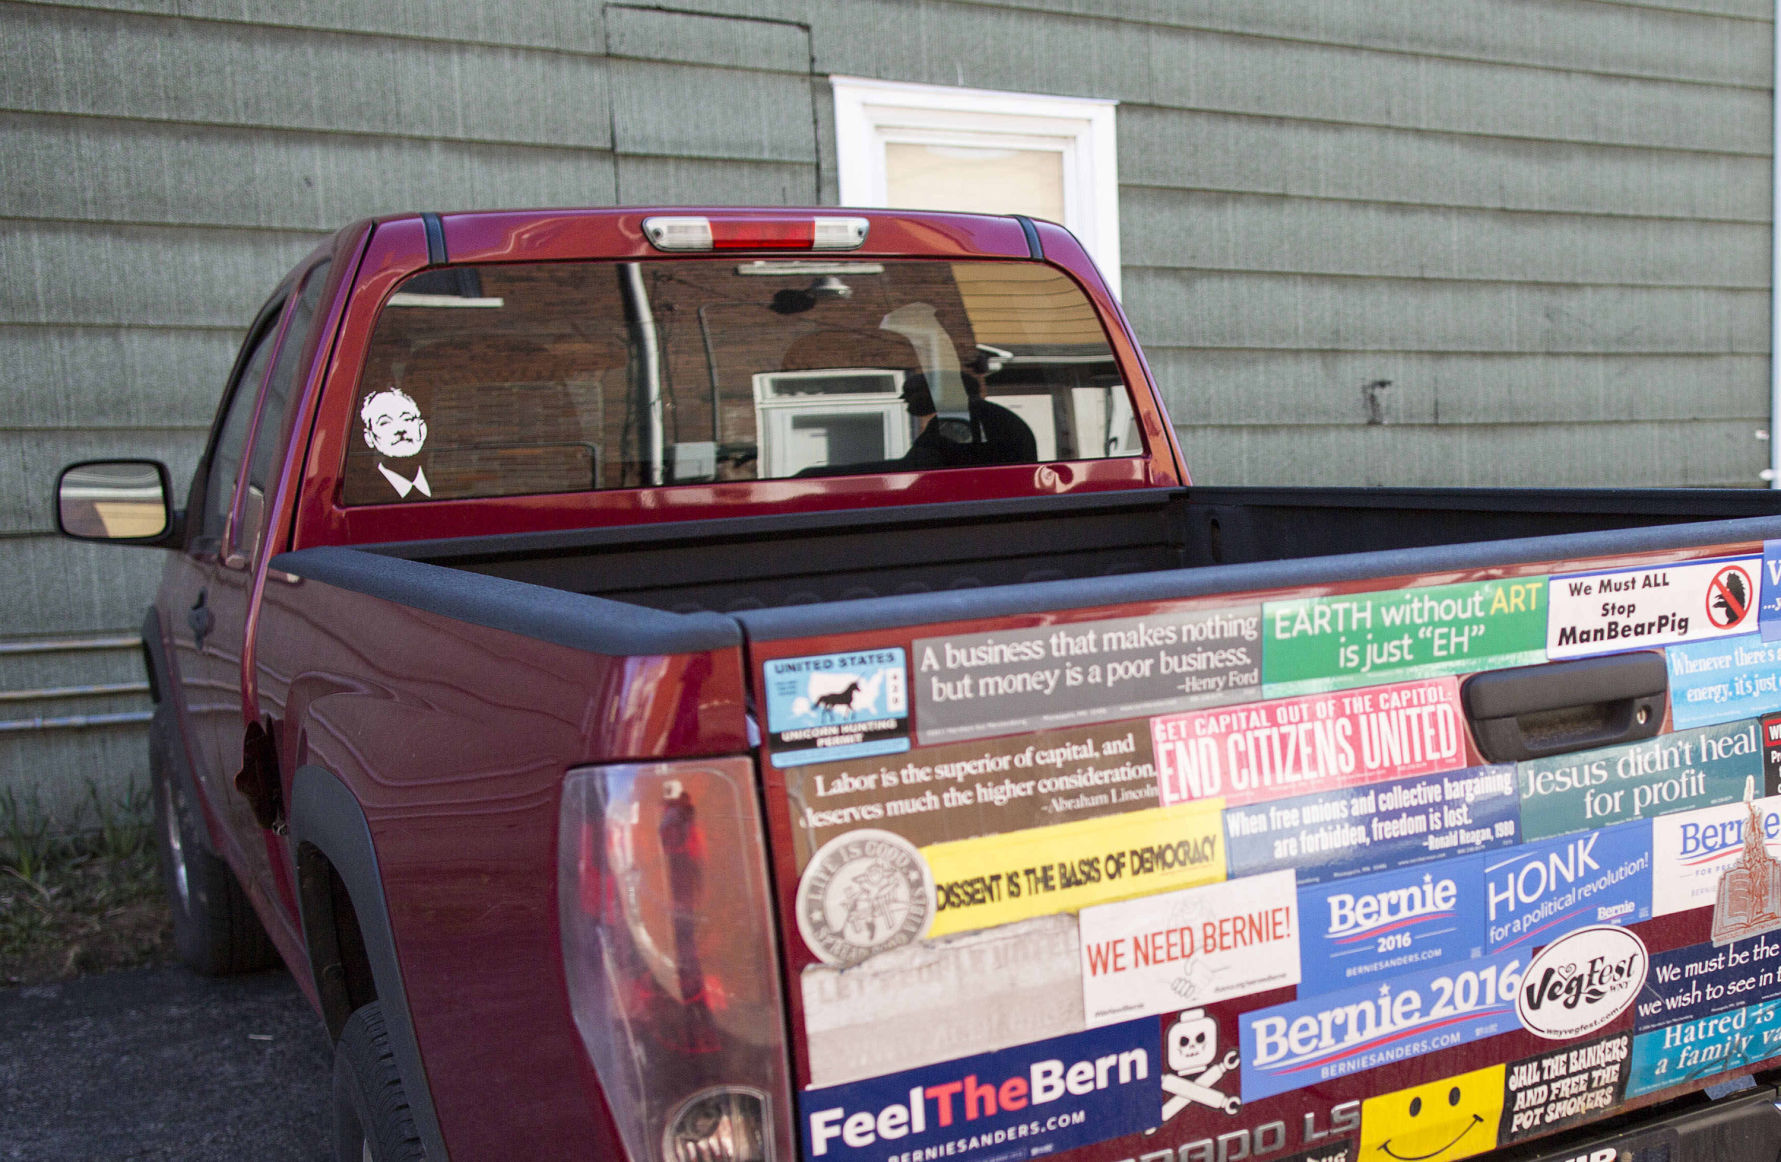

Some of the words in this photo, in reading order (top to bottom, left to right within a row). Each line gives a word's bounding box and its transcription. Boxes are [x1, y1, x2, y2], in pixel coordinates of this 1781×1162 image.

[1569, 582, 1592, 597] We
[1598, 576, 1637, 594] Must
[1642, 572, 1670, 588] ALL
[1275, 601, 1372, 639] EARTH
[1381, 590, 1485, 627] without
[1490, 583, 1543, 615] ART
[1557, 613, 1690, 647] ManBearPig
[1601, 602, 1636, 619] Stop
[774, 659, 833, 674] UNITED
[838, 652, 895, 668] STATES
[920, 646, 940, 673] A
[945, 638, 1046, 668] business
[1049, 628, 1098, 657] that
[1102, 623, 1177, 650] makes
[1181, 614, 1258, 642] nothing
[1339, 636, 1359, 668] is
[1360, 633, 1413, 672] just
[1670, 651, 1732, 676] Whenever
[931, 674, 973, 702] but
[979, 667, 1060, 696] money
[1065, 662, 1084, 686] is
[1088, 665, 1102, 683] a
[1107, 657, 1154, 687] poor
[1159, 646, 1252, 674] business.
[1228, 668, 1258, 687] Ford
[1753, 673, 1777, 697] just
[781, 726, 840, 742] UNICORN
[840, 718, 898, 734] HUNTING
[816, 733, 864, 748] PERMIT
[1155, 719, 1187, 742] GET
[1199, 708, 1270, 736] CAPITAL
[1276, 704, 1309, 724] OUT
[1316, 700, 1337, 719] OF
[1345, 694, 1374, 715] THE
[813, 771, 878, 797] Labor
[880, 767, 899, 790] is
[901, 764, 933, 784] the
[934, 754, 1012, 783] superior
[1013, 746, 1037, 768] of
[1035, 739, 1101, 772] capital,
[1102, 733, 1135, 755] and
[1158, 737, 1221, 802] END
[1227, 717, 1355, 789] CITIZENS
[1360, 703, 1458, 770] UNITED
[1522, 760, 1609, 799] Jesus
[1617, 740, 1693, 778] didn't
[1700, 725, 1757, 763] heal
[886, 792, 941, 818] much
[943, 786, 975, 808] the
[977, 778, 1035, 807] higher
[1037, 762, 1159, 794] consideration.
[1110, 784, 1159, 803] Lincoln
[1226, 808, 1267, 838] When
[1270, 804, 1300, 829] free
[1302, 797, 1348, 822] unions
[1350, 790, 1376, 814] and
[1378, 780, 1442, 811] collective
[1443, 771, 1514, 803] bargaining
[1585, 789, 1625, 819] for
[1633, 770, 1706, 815] profit
[1274, 838, 1297, 859] are
[1300, 827, 1371, 853] forbidden,
[1371, 815, 1428, 841] freedom
[1429, 810, 1442, 831] is
[1443, 804, 1472, 826] lost.
[937, 876, 1002, 911] DISSENT
[1008, 872, 1021, 897] IS
[1024, 866, 1055, 895] THE
[1058, 857, 1101, 887] BASIS
[1104, 852, 1126, 880] OF
[1131, 835, 1218, 877] DEMOCRACY
[1488, 832, 1600, 921] HONK
[1327, 873, 1457, 933] Bernie
[1490, 922, 1512, 944] for
[1512, 919, 1521, 933] a
[1522, 887, 1575, 932] political
[1577, 852, 1648, 900] revolution!
[1597, 901, 1635, 921] Bernie
[1086, 938, 1126, 977] WE
[1133, 926, 1194, 969] NEED
[1202, 906, 1291, 954] BERNIE!
[1346, 948, 1442, 978] BERNIESANDERS.COM
[1377, 932, 1411, 952] 2016
[1656, 963, 1681, 984] We
[1685, 952, 1726, 977] must
[1728, 943, 1749, 966] be
[1753, 936, 1780, 961] the
[1526, 953, 1638, 1010] VegFest
[1638, 1001, 1662, 1017] we
[1665, 980, 1701, 1010] wish
[1706, 984, 1724, 1000] to
[1727, 980, 1756, 995] see
[1759, 969, 1773, 986] in
[1251, 983, 1422, 1066] Bernie
[1430, 960, 1522, 1017] 2016
[1546, 1008, 1619, 1036] wnyvegfest.com
[1663, 1007, 1747, 1049] Hatred
[1755, 1003, 1775, 1024] is
[1321, 1032, 1461, 1079] BERNIESANDERS.COM
[1509, 1063, 1541, 1091] JAIL
[1542, 1055, 1568, 1080] THE
[1569, 1035, 1629, 1072] BANKERS
[1655, 1058, 1668, 1075] a
[1677, 1032, 1754, 1070] family
[809, 1048, 1149, 1157] FeelTheBern
[1511, 1107, 1543, 1132] POT
[1545, 1087, 1613, 1122] SMOKERS
[1513, 1084, 1548, 1112] AND
[1550, 1075, 1588, 1100] FREE
[1592, 1063, 1620, 1086] THE
[888, 1110, 1085, 1162] BERNIESANDERS.COM
[1303, 1100, 1360, 1142] LS
